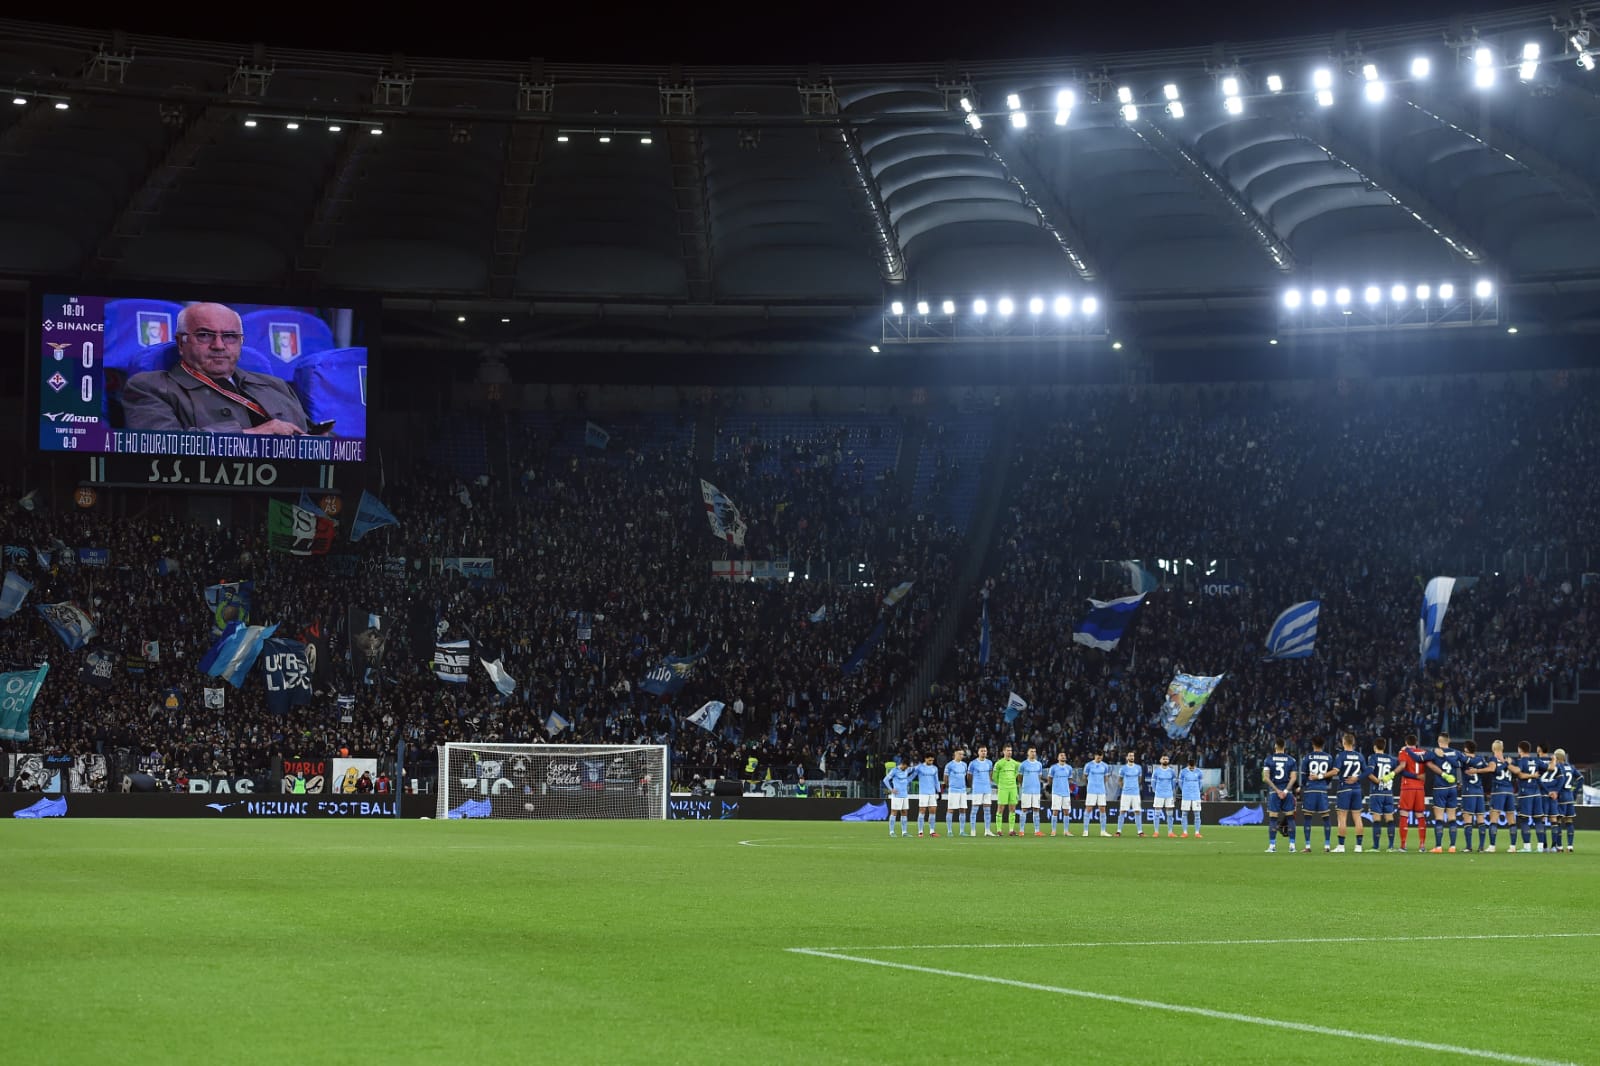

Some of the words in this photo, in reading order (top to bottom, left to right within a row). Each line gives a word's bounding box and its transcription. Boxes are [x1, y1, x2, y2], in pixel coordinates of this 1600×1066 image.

[62, 304, 84, 316] 18:01
[57, 321, 104, 332] BINANCE
[82, 341, 93, 368] 0
[81, 375, 93, 402] 0
[63, 436, 77, 448] 0:0
[104, 432, 110, 452] A
[113, 432, 122, 452] TE
[125, 433, 138, 453] HO
[141, 433, 178, 455] GIURATO
[181, 432, 216, 456] FEDELTÀ
[261, 438, 270, 458] TE
[272, 435, 296, 459] DARÒ
[299, 439, 331, 460] ETERNO
[333, 441, 362, 461] AMORE
[149, 460, 190, 483] S.S.
[200, 460, 277, 485] LAZIO
[284, 761, 325, 775] DIABLO
[1274, 762, 1285, 779] 3
[1343, 761, 1361, 778] 72
[1441, 761, 1452, 774] 4
[1564, 772, 1573, 789] 2
